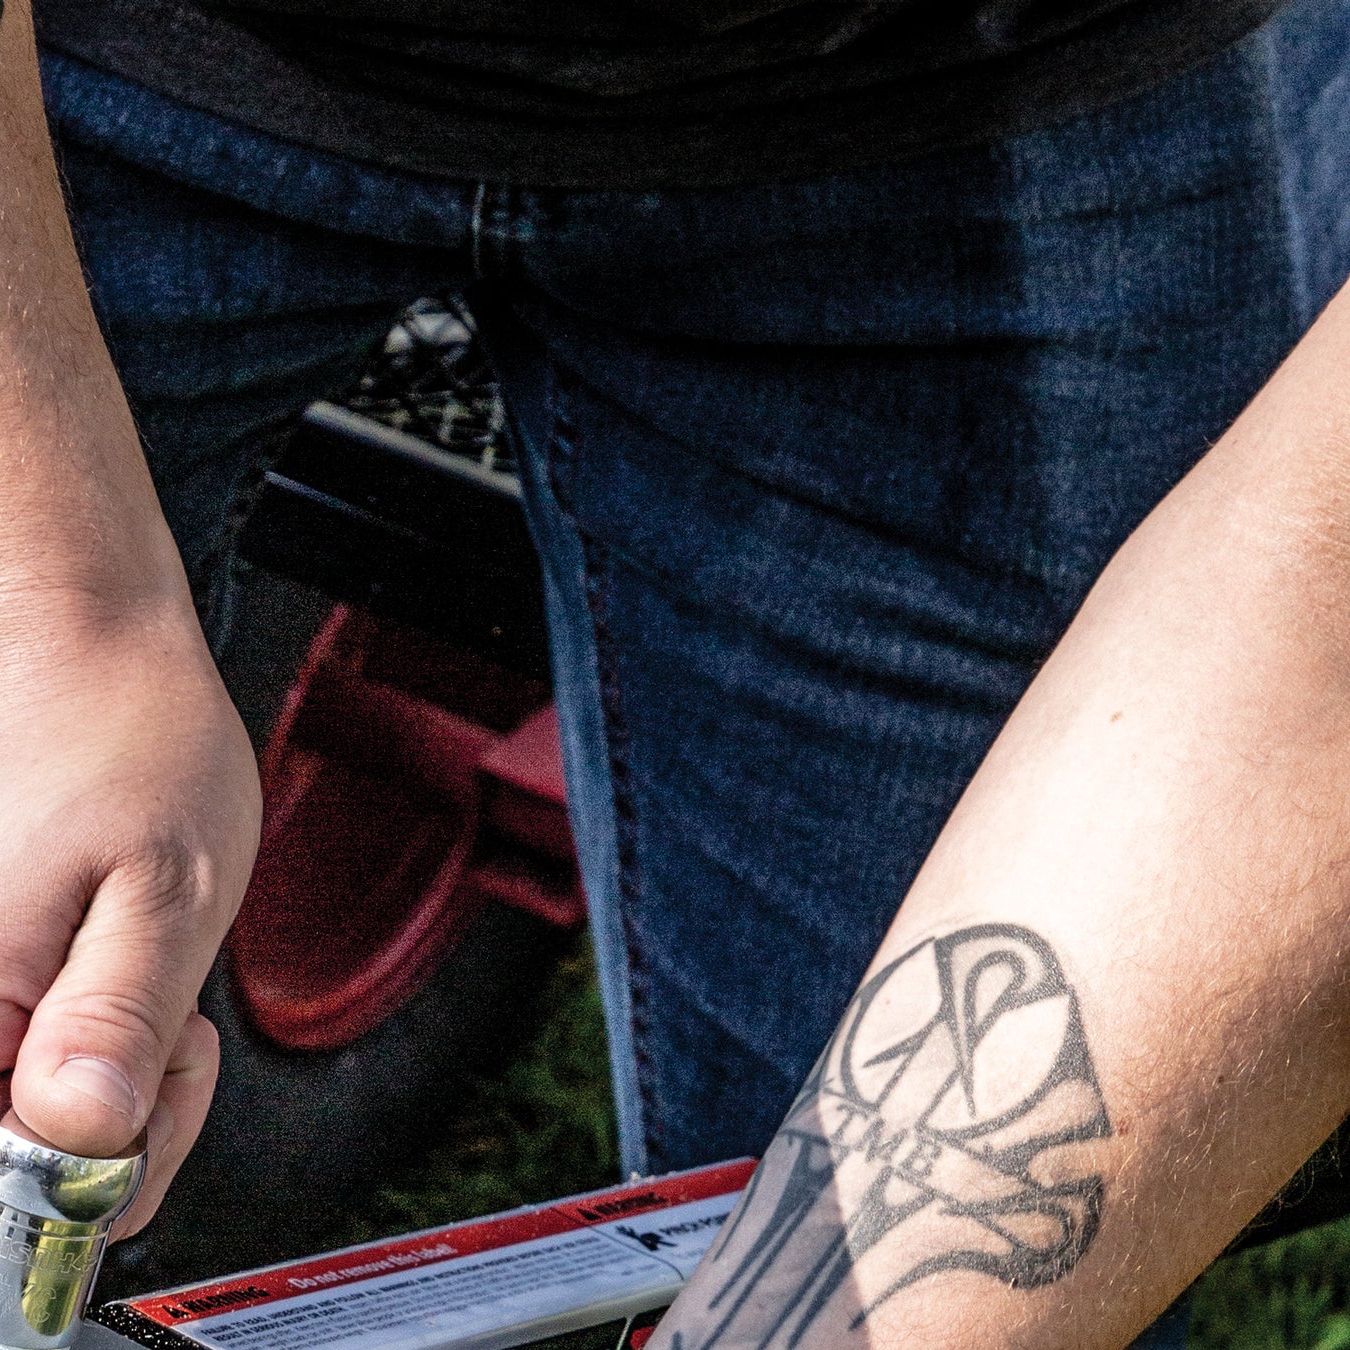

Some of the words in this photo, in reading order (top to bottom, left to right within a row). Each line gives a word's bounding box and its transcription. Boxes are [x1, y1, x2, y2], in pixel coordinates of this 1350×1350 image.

[288, 1276, 313, 1289] Do
[312, 1269, 341, 1283] not
[338, 1259, 392, 1277] remove
[387, 1251, 417, 1265] this
[184, 1286, 270, 1314] WARNING
[213, 1331, 242, 1341] RESULT
